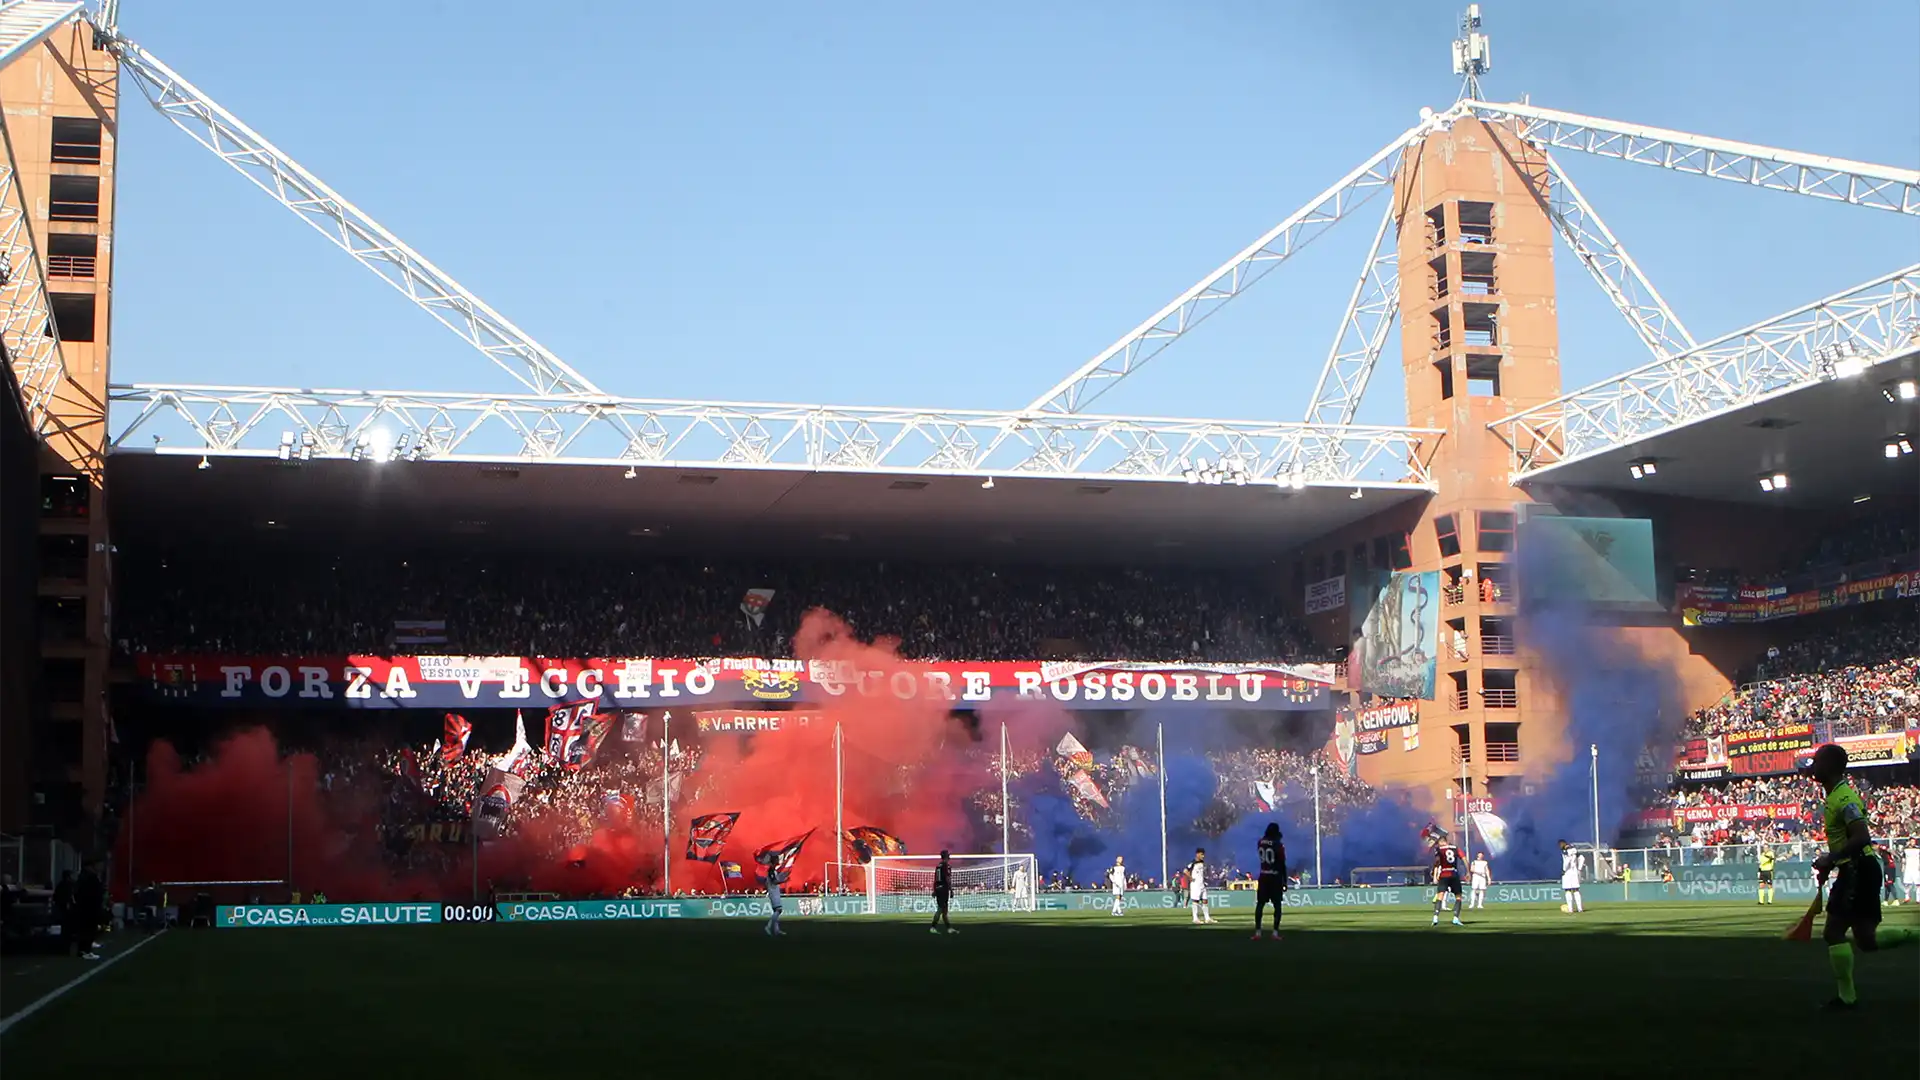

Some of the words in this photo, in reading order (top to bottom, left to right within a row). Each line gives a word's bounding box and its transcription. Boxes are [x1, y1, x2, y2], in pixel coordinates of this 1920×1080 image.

[419, 657, 450, 667] CIAO
[772, 659, 805, 672] ZENA
[1049, 661, 1075, 678] CIAO
[421, 668, 481, 678] TESTONE
[220, 666, 417, 699] FORZA
[458, 667, 715, 698] VECCHIO
[1014, 671, 1266, 702] ROSSOBLU
[1848, 751, 1888, 762] OREGINA
[1468, 799, 1493, 812] sette
[1686, 808, 1713, 820] GENOA
[1717, 806, 1738, 818] CLUB
[1777, 806, 1797, 818] CLUB
[1445, 849, 1456, 864] 8
[1281, 893, 1314, 907] ASA
[1334, 891, 1401, 905] SALUTE
[1499, 887, 1562, 901] SALUTE
[525, 905, 578, 920] CASA
[604, 903, 682, 919] SALUTE
[722, 902, 773, 917] CASA
[825, 900, 871, 915] LUTE
[913, 897, 962, 913] CAA
[246, 908, 310, 925] CASA
[313, 917, 338, 925] DELLA
[340, 906, 432, 924] SALUTE
[444, 905, 493, 922] 00:00
